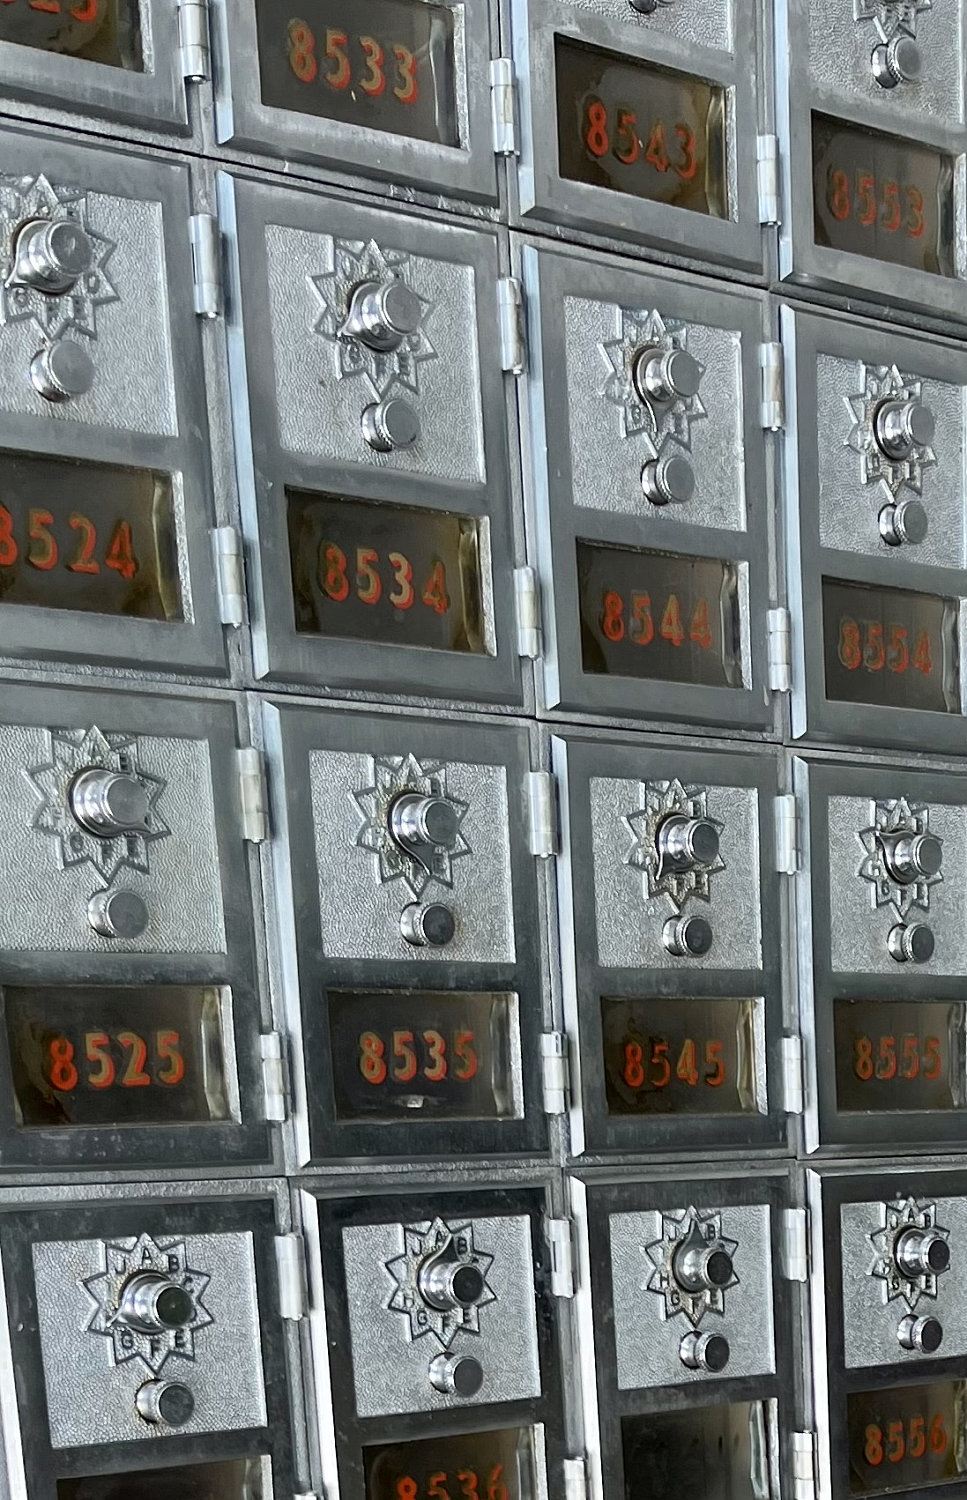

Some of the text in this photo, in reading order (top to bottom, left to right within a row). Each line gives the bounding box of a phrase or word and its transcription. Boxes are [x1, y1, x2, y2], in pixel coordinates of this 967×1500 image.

[288, 18, 417, 104] 8533
[587, 99, 698, 180] 8543
[828, 166, 927, 238] 8553
[0, 508, 135, 577] 8524
[320, 541, 451, 615] 8534
[600, 590, 713, 648] 8544
[839, 619, 931, 674] 8554
[49, 1030, 184, 1092] 8525
[359, 1030, 476, 1085] 8535
[623, 1038, 727, 1088] 8545
[855, 1037, 943, 1080] 8555
[863, 1414, 947, 1466] 8556
